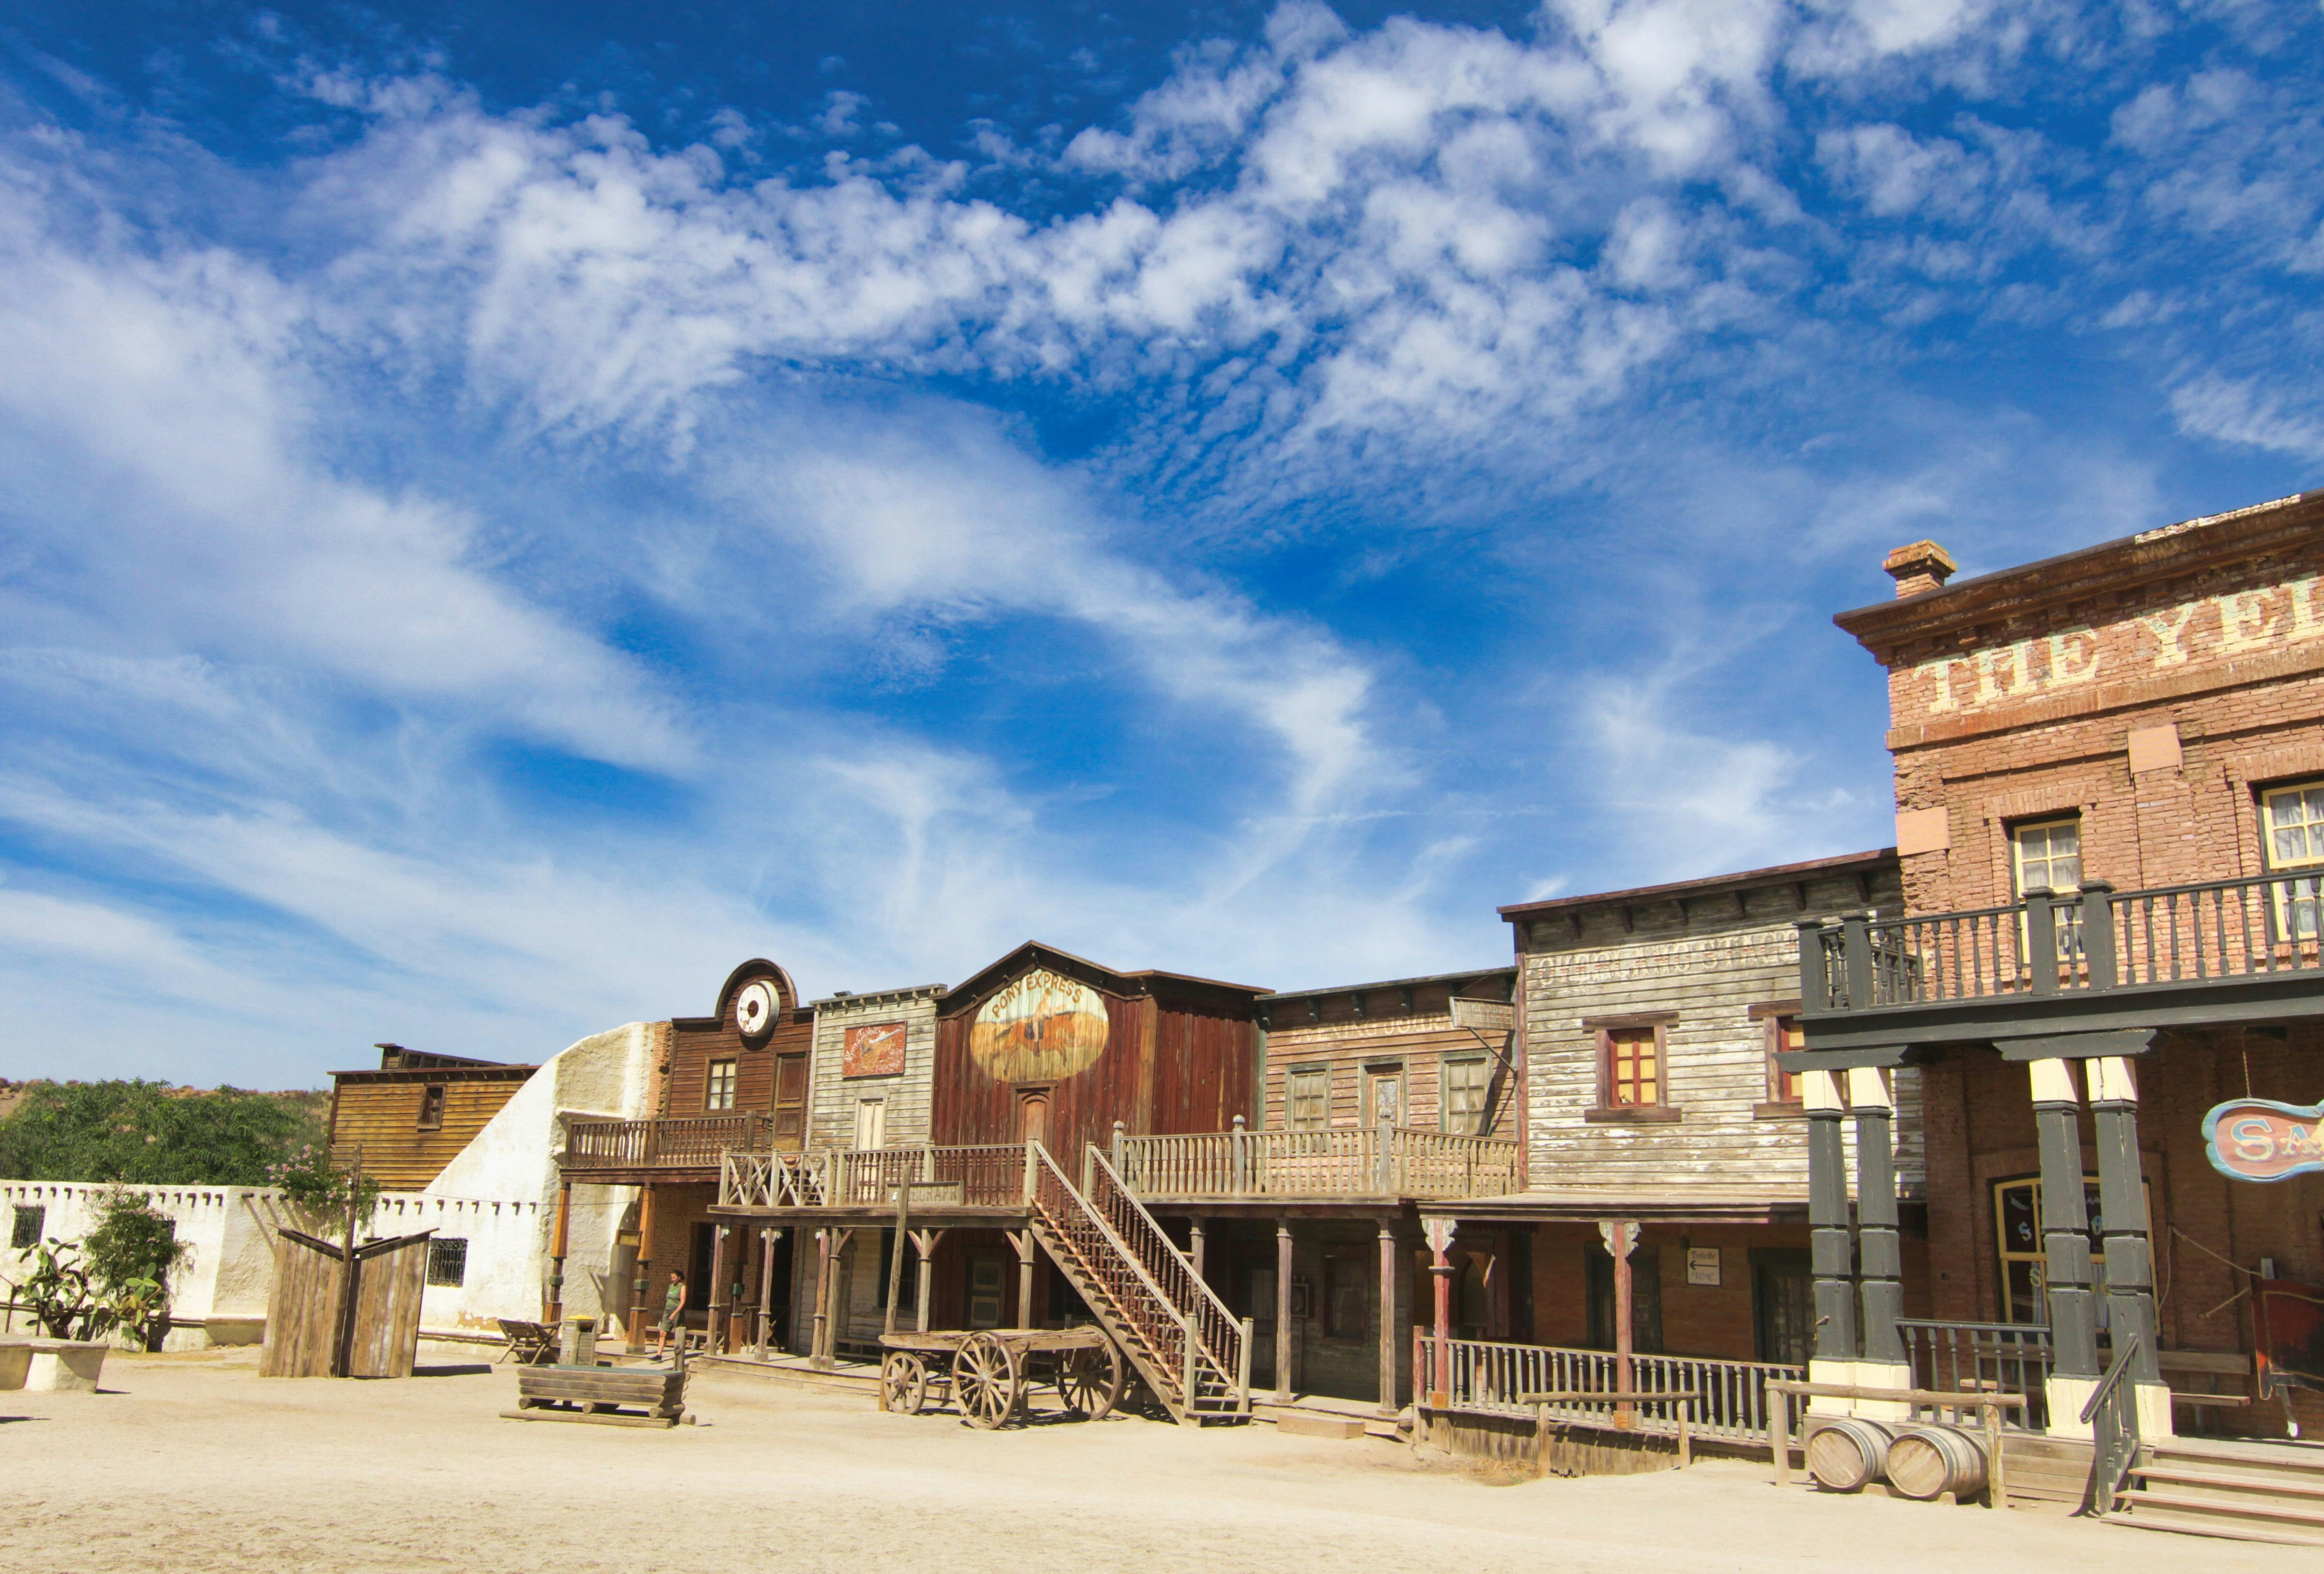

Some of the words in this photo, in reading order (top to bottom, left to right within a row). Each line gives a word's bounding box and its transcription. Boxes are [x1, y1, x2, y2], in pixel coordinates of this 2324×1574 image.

[1913, 623, 2100, 713] THE
[1537, 944, 1690, 986] OVERLAND
[992, 979, 1023, 1019] PONY
[1026, 973, 1083, 1003] EXPRESS
[1290, 1018, 1377, 1044] EVENING
